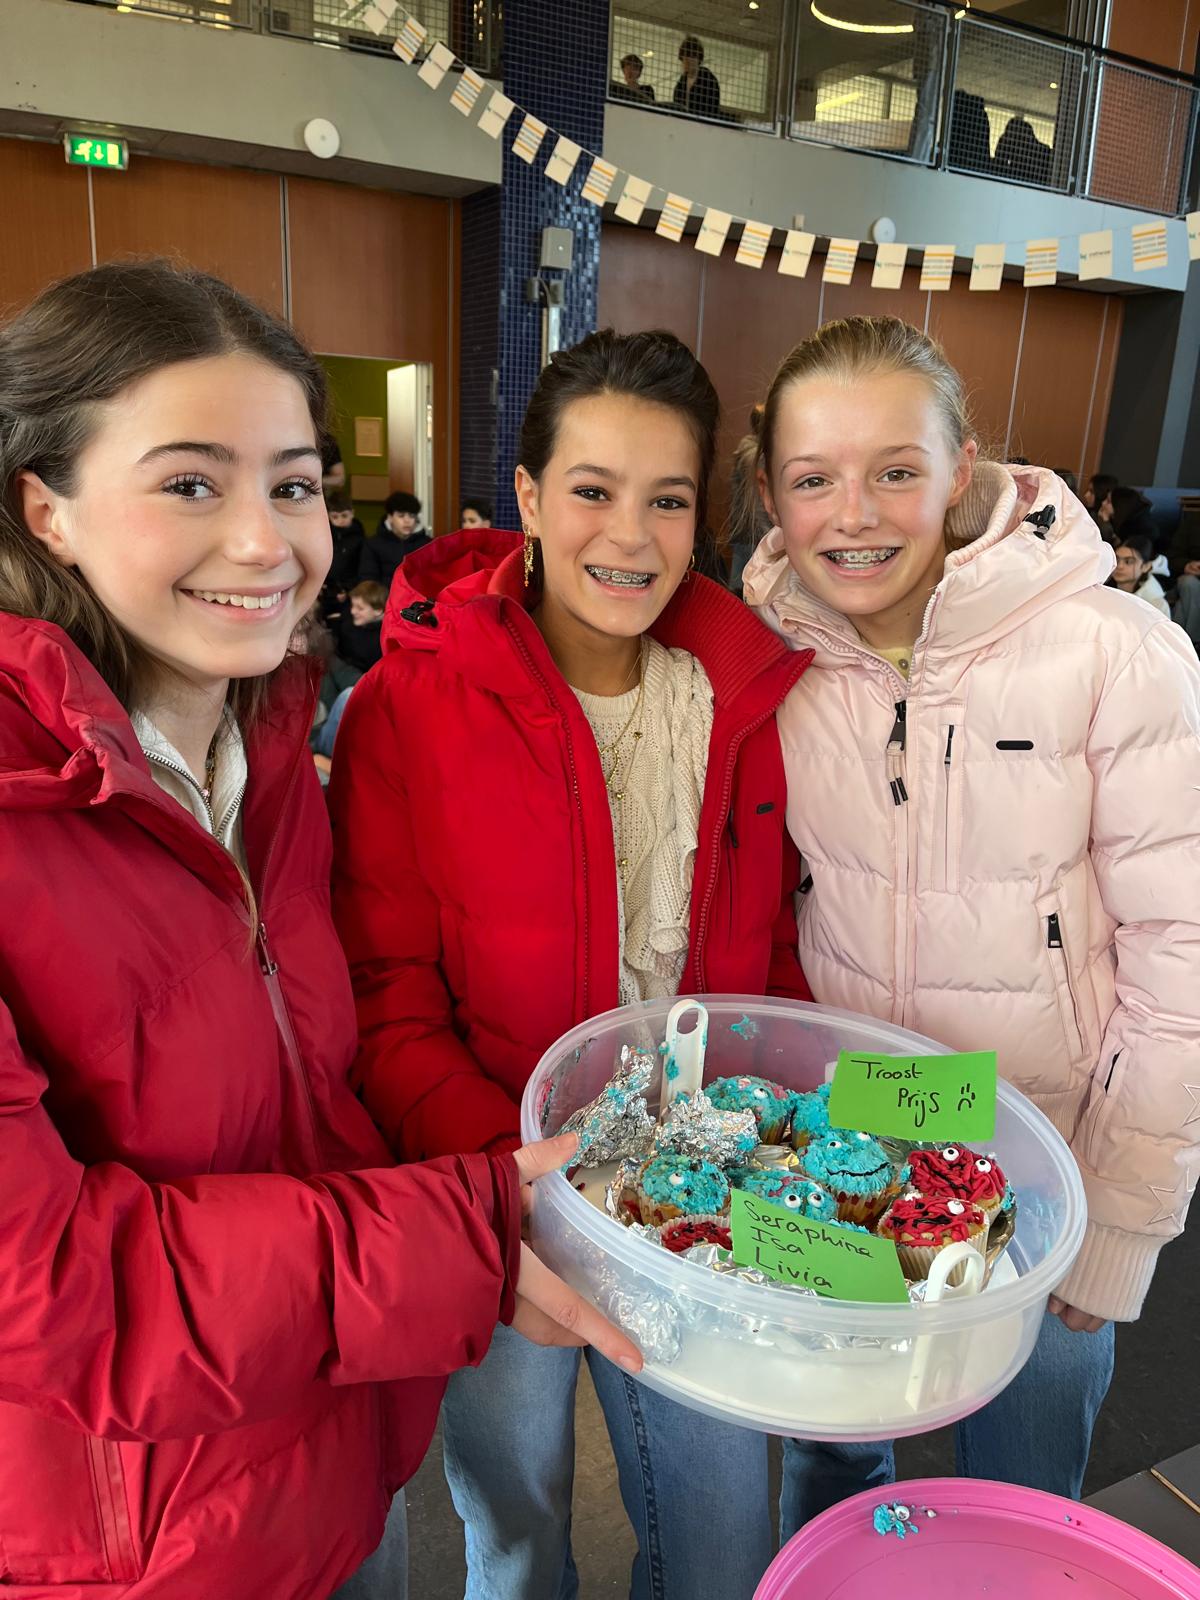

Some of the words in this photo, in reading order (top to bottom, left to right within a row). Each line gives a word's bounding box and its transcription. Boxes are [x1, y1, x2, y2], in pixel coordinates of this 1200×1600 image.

[850, 1059, 923, 1080] Troost
[897, 1086, 940, 1128] Prijs
[743, 1200, 874, 1258] Seraphina
[750, 1225, 805, 1256] Isa
[755, 1246, 833, 1288] Livia
